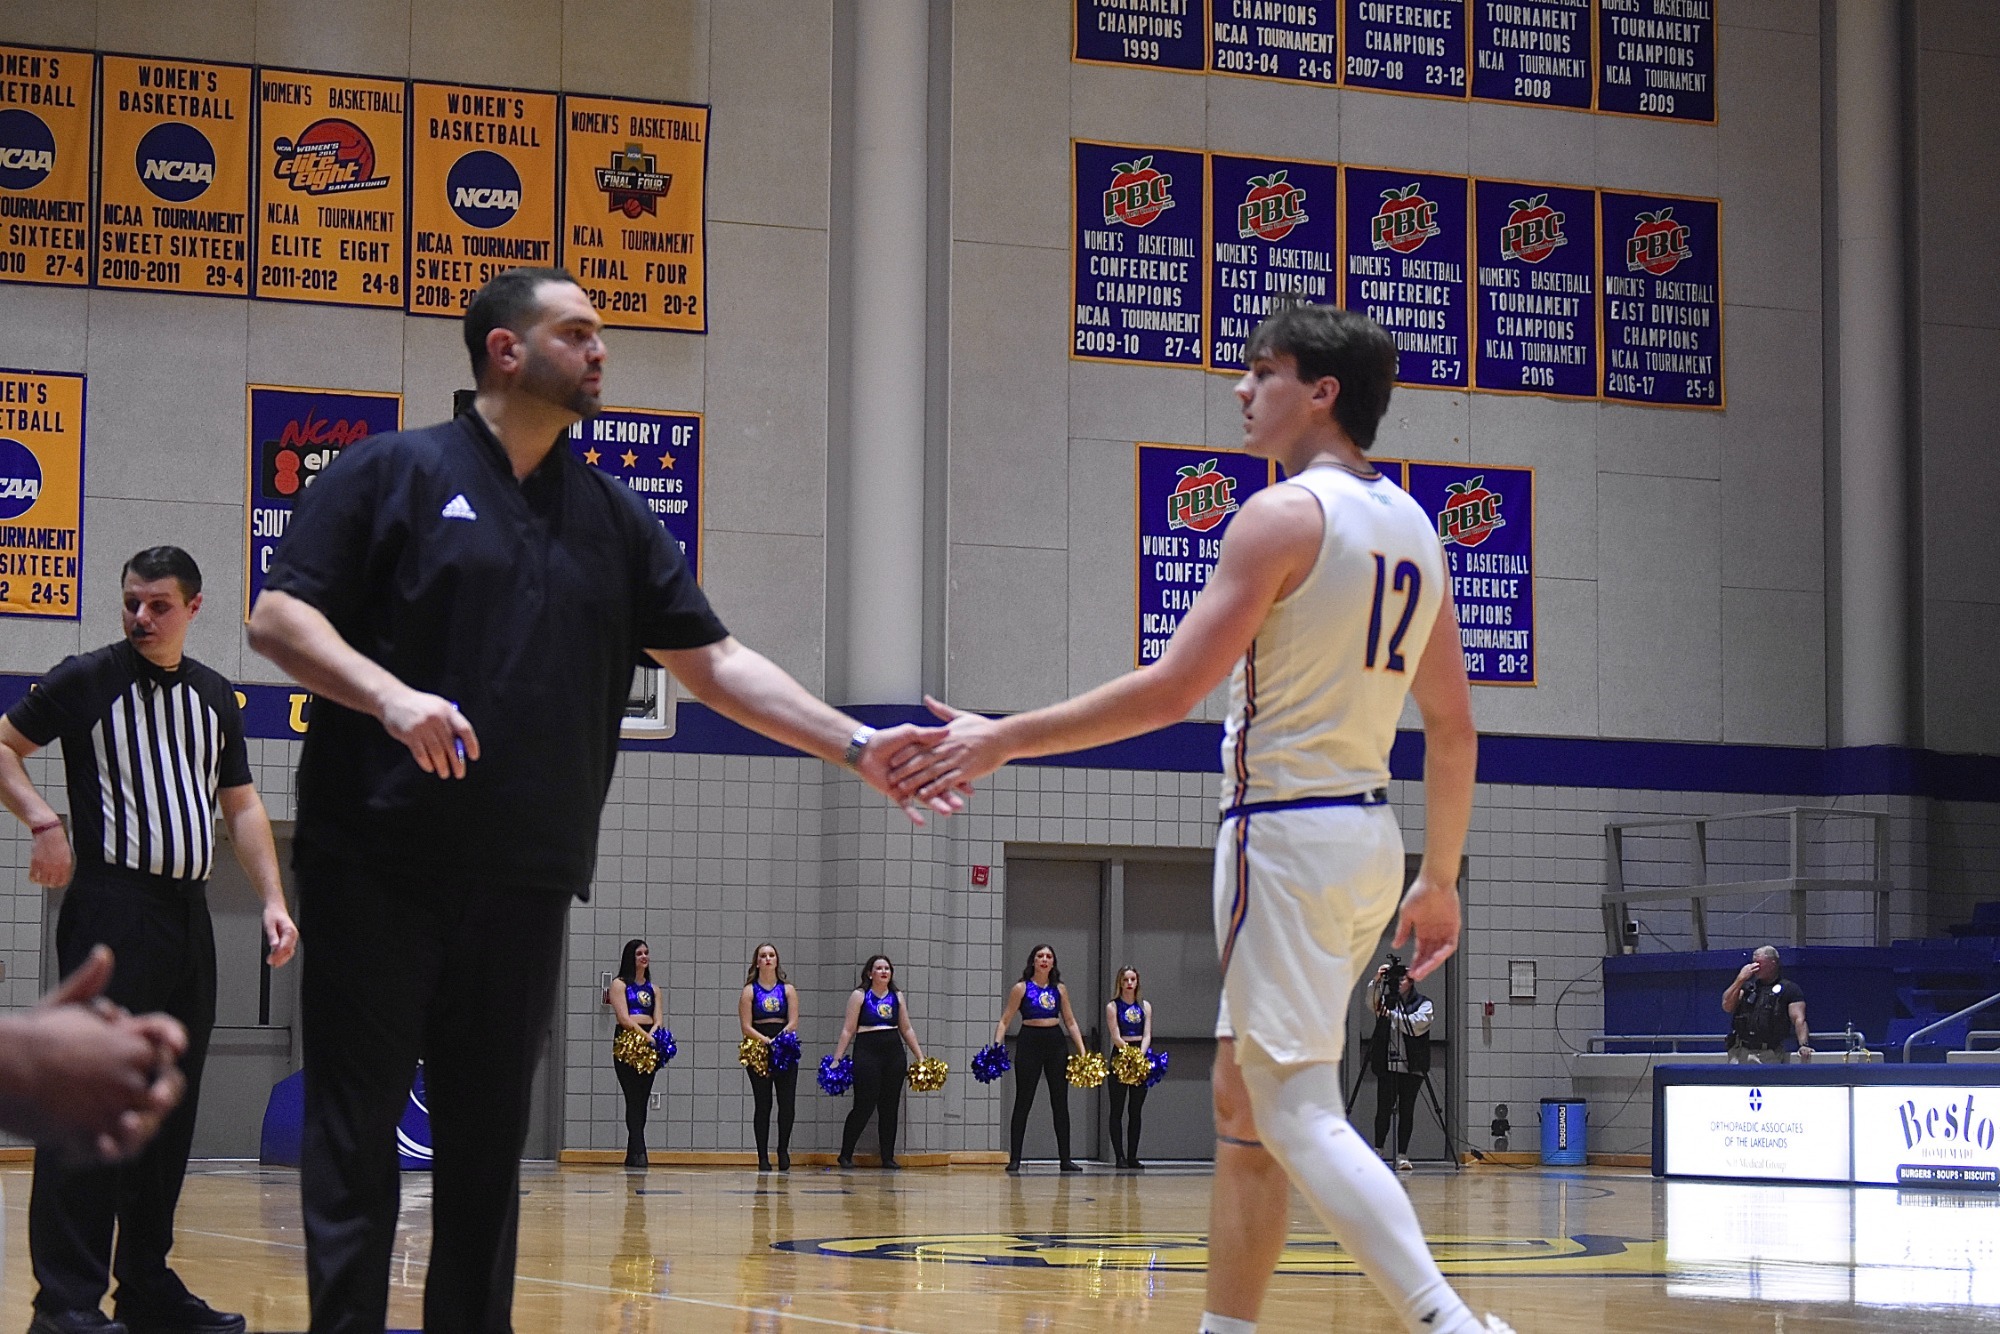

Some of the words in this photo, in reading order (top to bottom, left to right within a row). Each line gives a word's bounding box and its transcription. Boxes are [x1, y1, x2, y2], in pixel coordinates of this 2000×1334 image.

[1233, 0, 1316, 25] CHAMPIONS
[1359, 2, 1452, 29] CONFERENCE
[1487, 3, 1577, 30] TOURNAMENT
[1653, 0, 1710, 20] BASKETBALL
[1099, 12, 1182, 39] CHAMPIONS
[1215, 22, 1248, 44] NCAA
[1256, 27, 1334, 54] TOURNAMENT
[1612, 16, 1700, 43] TOURNAMENT
[1123, 38, 1159, 61] 1999
[1366, 30, 1445, 56] CHAMPIONS
[1493, 28, 1570, 53] CHAMPIONS
[1218, 50, 1278, 74] 2003-04
[1300, 58, 1331, 80] 24-6
[1479, 50, 1504, 71] NCAA
[1519, 54, 1586, 78] TOURNAMENT
[1619, 42, 1693, 67] CHAMPIONS
[139, 66, 217, 92] WOMEN'S
[1348, 56, 1403, 80] 2007-08
[1426, 65, 1464, 86] 23-12
[1606, 65, 1631, 85] NCAA
[1645, 69, 1706, 92] TOURNAMENT
[262, 81, 311, 106] WOMEN'S
[329, 88, 402, 113] BASKETBALL
[1515, 78, 1551, 98] 2008
[119, 91, 234, 120] BASKETBALL
[448, 93, 523, 119] WOMEN'S
[1640, 93, 1674, 113] 2009
[430, 118, 540, 147] BASKETBALL
[572, 111, 619, 135] WOMEN'S
[630, 117, 701, 142] BASKETBALL
[297, 143, 339, 152] WOMEN'S
[144, 159, 213, 183] NCAA
[603, 175, 631, 188] FINAL
[637, 178, 662, 191] FOUR
[348, 180, 386, 189] ANTONIO
[1104, 174, 1172, 218] PBC
[0, 196, 85, 222] OURNAMENT
[454, 187, 519, 210] NCAA
[1239, 189, 1306, 231] PBC
[104, 204, 143, 226] NCAA
[152, 207, 244, 234] TOURNAMENT
[268, 203, 299, 225] NCAA
[318, 207, 394, 232] TOURNAMENT
[1372, 202, 1438, 242] PBC
[10, 224, 85, 250] SIXTEEN
[573, 225, 603, 247] NCAA
[622, 229, 694, 254] TOURNAMENT
[1084, 230, 1123, 252] WOMEN'S
[1139, 234, 1195, 258] BASKETBALL
[1502, 212, 1565, 252] PBC
[1628, 226, 1690, 264] PBC
[103, 231, 163, 255] SWEET
[170, 236, 244, 261] SIXTEEN
[272, 235, 322, 258] ELITE
[340, 240, 389, 263] EIGHT
[417, 232, 453, 254] NCAA
[462, 236, 550, 261] TOURNAMENT
[1216, 242, 1257, 264] WOMEN'S
[1269, 247, 1332, 272] BASKETBALL
[46, 254, 83, 277] 27-4
[103, 259, 180, 283] 2010-2011
[207, 266, 243, 288] 29-4
[416, 258, 472, 282] SWEET
[580, 257, 628, 280] FINAL
[646, 262, 686, 284] FOUR
[1090, 256, 1188, 282] CONFERENCE
[1350, 255, 1390, 276] WOMEN'S
[1402, 258, 1462, 283] BASKETBALL
[262, 266, 337, 290] 2011-2012
[363, 273, 398, 294] 24-8
[1222, 268, 1257, 289] EAST
[1265, 272, 1325, 296] DIVISION
[1361, 280, 1450, 306] CONFERENCE
[1479, 267, 1520, 288] WOMEN'S
[1532, 271, 1591, 294] BASKETBALL
[1606, 276, 1645, 298] WOMEN'S
[1656, 280, 1714, 303] BASKETBALL
[664, 295, 696, 315] 20-2
[1097, 282, 1181, 307] CHAMPIONS
[1233, 294, 1313, 315] CHAMPI
[1490, 292, 1579, 317] TOURNAMENT
[1077, 305, 1110, 327] NCAA
[1121, 308, 1200, 333] TOURNAMENT
[1368, 305, 1445, 329] CHAMPIONS
[1611, 301, 1644, 322] EAST
[1652, 304, 1709, 327] DIVISION
[1221, 317, 1249, 338] NCAA
[1497, 316, 1574, 340] CHAMPIONS
[1624, 326, 1698, 350] CHAMPIONS
[1077, 330, 1139, 354] 2009-10
[1165, 338, 1200, 358] 27-4
[1391, 331, 1457, 355] TOURNAMENT
[1486, 339, 1513, 360] NCAA
[1521, 342, 1587, 365] TOURNAMENT
[1432, 359, 1460, 380] 25-7
[1612, 349, 1638, 369] NCAA
[1646, 352, 1712, 374] TOURNAMENT
[1522, 366, 1554, 387] 2016
[1609, 373, 1654, 395] 2016-17
[1687, 380, 1714, 399] 25-8
[279, 404, 368, 448] NCAA
[593, 420, 661, 444] MEMORY
[672, 425, 693, 446] OF
[629, 476, 683, 493] ANDREWS
[1168, 477, 1236, 521] PBC
[1438, 494, 1502, 537] PBC
[1143, 536, 1189, 557] WOMEN'S
[1199, 539, 1220, 558] BAS
[0, 553, 76, 578] SIXTEEN
[1467, 553, 1529, 574] BASKETBALL
[32, 582, 69, 604] 24-5
[1144, 613, 1176, 633] NCAA
[1363, 551, 1422, 673] 12
[1499, 654, 1528, 673] 20-2
[1711, 1122, 1759, 1132] ORTHOPAEDIC
[1761, 1122, 1803, 1133] ASSOCIATES
[1725, 1137, 1733, 1147] OF
[1737, 1137, 1747, 1147] THE
[1751, 1138, 1788, 1148] LAKELANDS
[1901, 1169, 1931, 1178] BURGERS
[1937, 1170, 1958, 1179] SOUPS
[1964, 1171, 1995, 1180] BISCUITS
